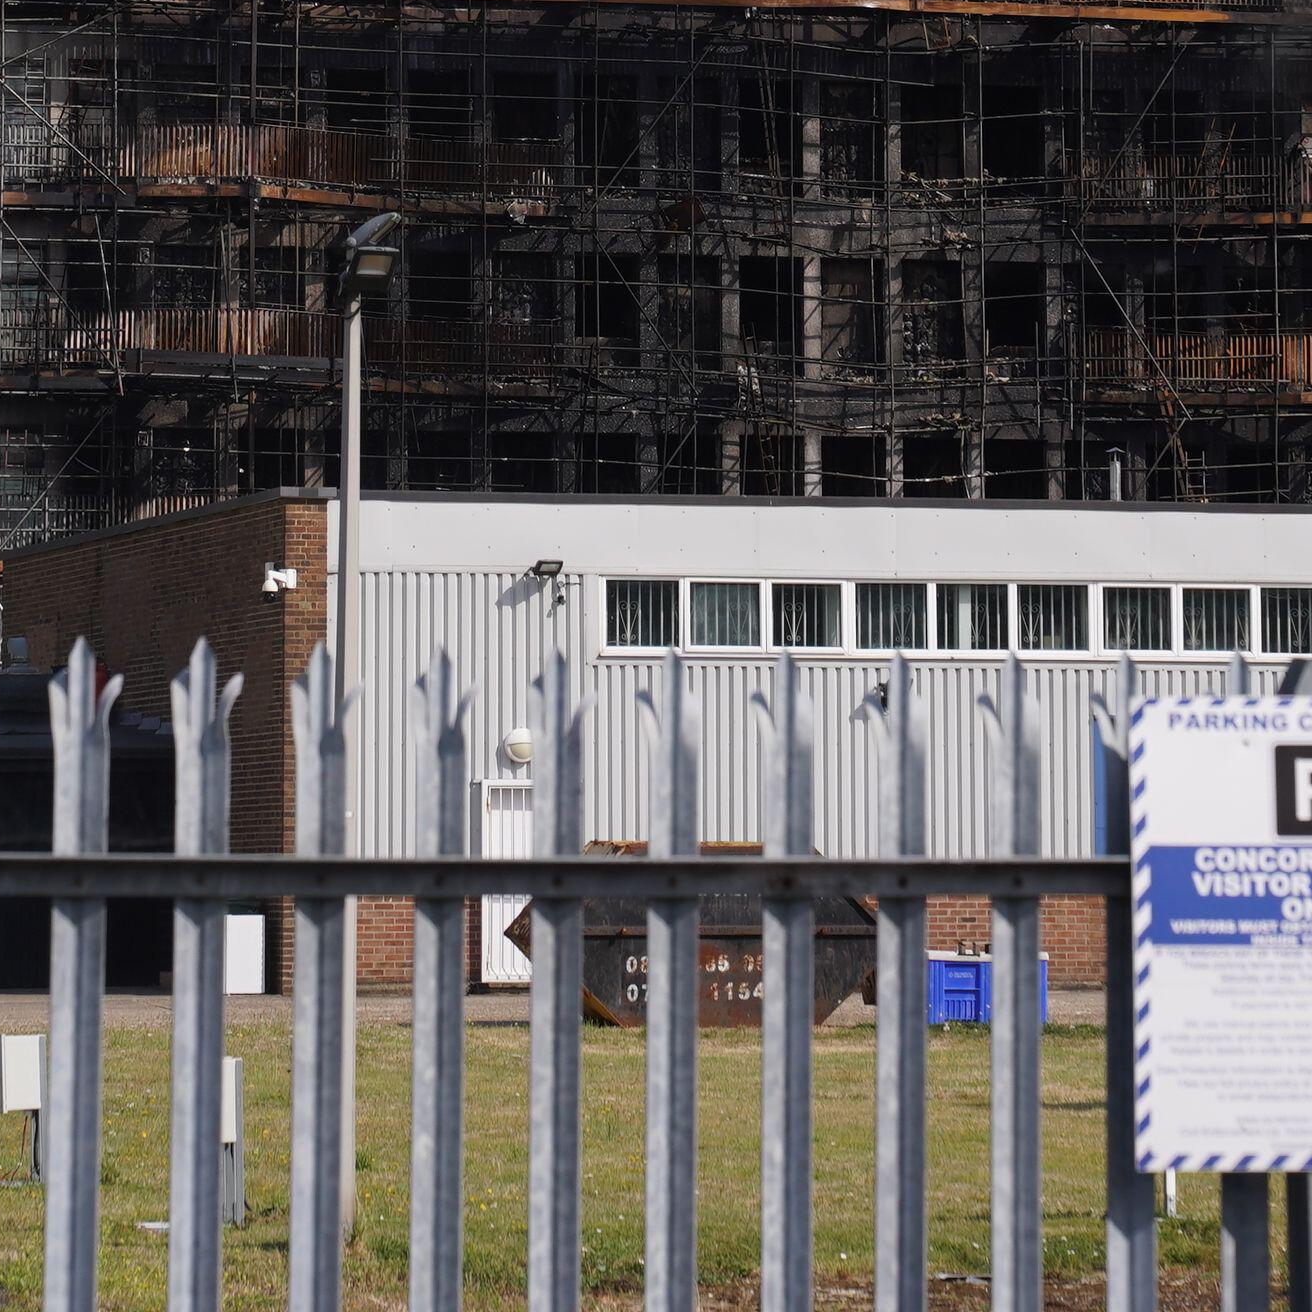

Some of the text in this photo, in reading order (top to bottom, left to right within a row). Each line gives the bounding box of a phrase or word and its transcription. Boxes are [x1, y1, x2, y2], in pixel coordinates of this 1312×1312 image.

[1168, 712, 1288, 732] PARKING
[1191, 871, 1312, 898] VISITOR
[1169, 918, 1237, 935] VISITORS
